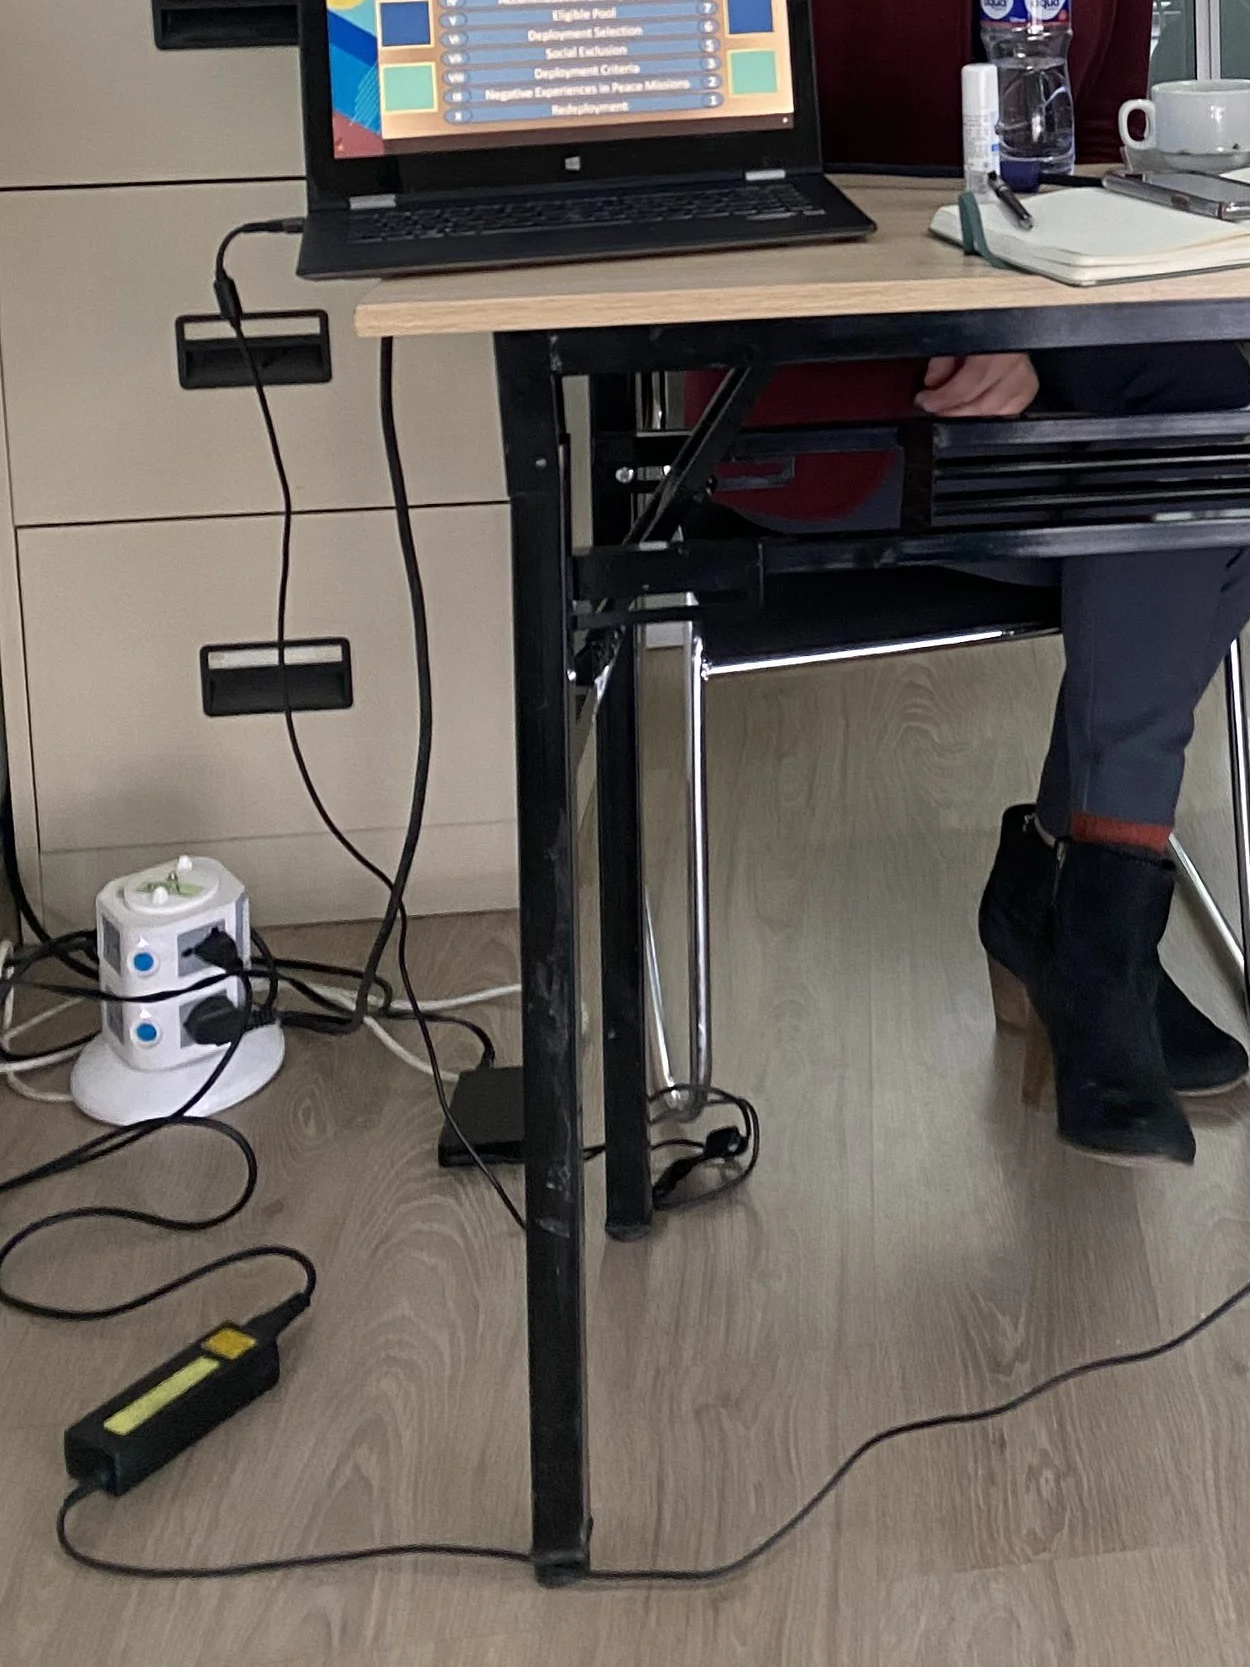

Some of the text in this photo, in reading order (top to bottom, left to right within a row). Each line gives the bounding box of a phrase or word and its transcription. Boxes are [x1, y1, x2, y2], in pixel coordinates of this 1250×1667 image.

[552, 9, 592, 22] Eligible
[592, 7, 617, 19] Pool
[527, 28, 593, 43] Deployment
[593, 25, 643, 36] Selection
[545, 47, 578, 60] Social
[578, 45, 628, 57] Exclusion
[533, 67, 600, 80] Deployment
[600, 63, 641, 76] Criteria
[485, 88, 533, 102] Negative
[534, 85, 598, 98] Experiences
[598, 83, 610, 93] in
[611, 82, 644, 93] Peace
[644, 78, 691, 91] Missions
[551, 101, 630, 116] Redeployment
